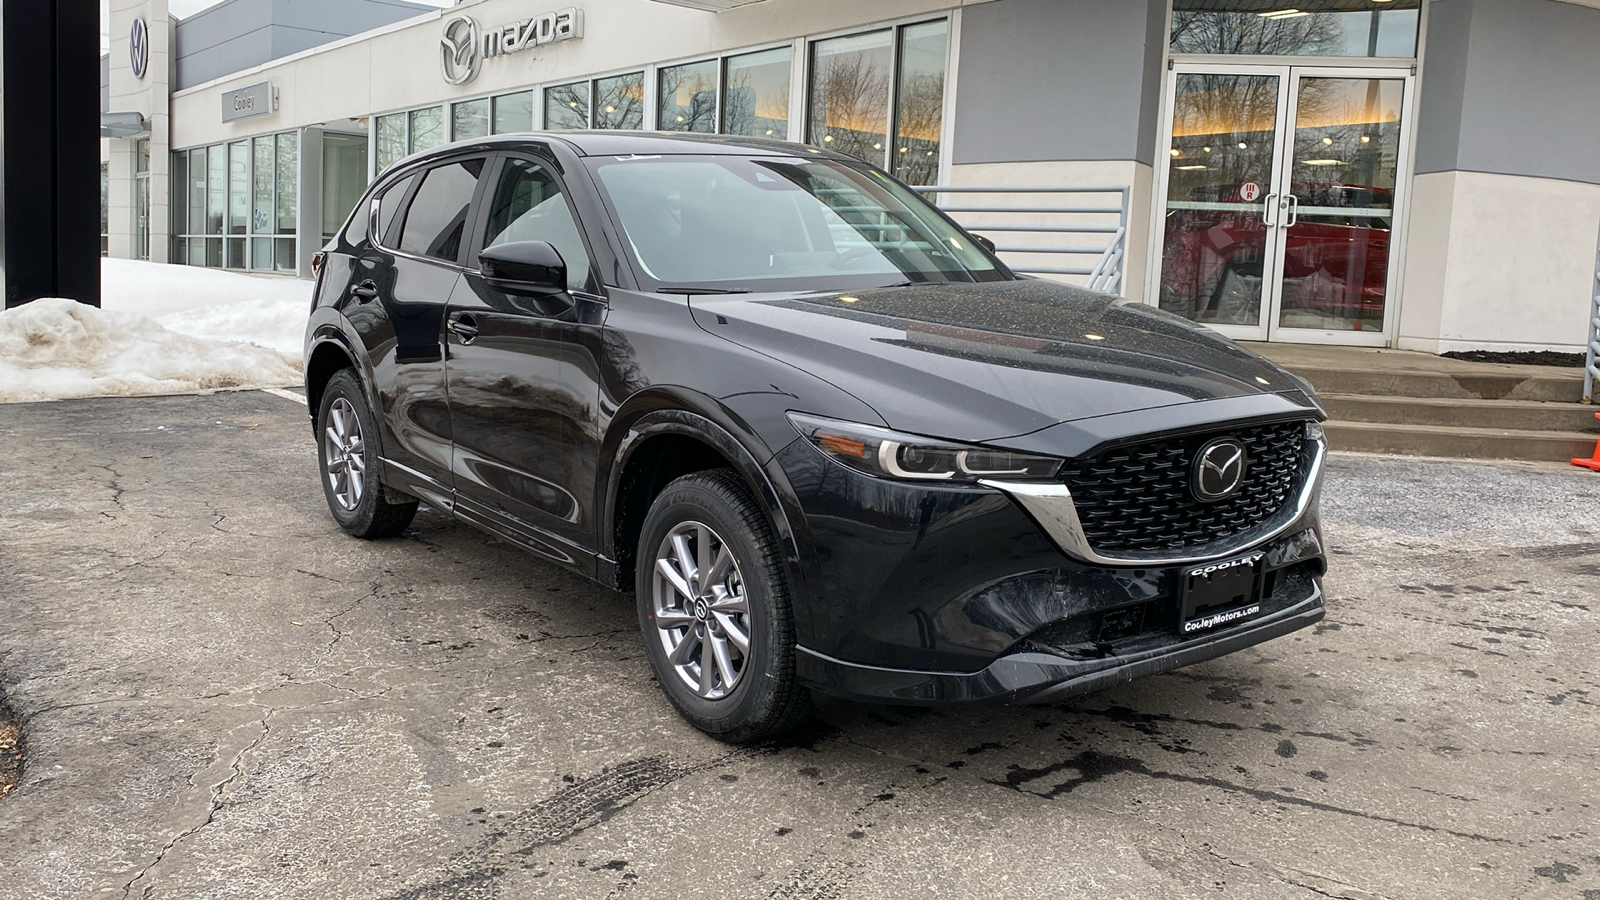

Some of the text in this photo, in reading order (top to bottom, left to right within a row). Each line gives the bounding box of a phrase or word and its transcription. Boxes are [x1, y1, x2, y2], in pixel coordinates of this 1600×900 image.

[481, 6, 580, 60] mazda
[233, 89, 256, 113] Cooley
[1191, 553, 1264, 576] COOLEY
[1184, 604, 1260, 632] CooleyMotors.com
